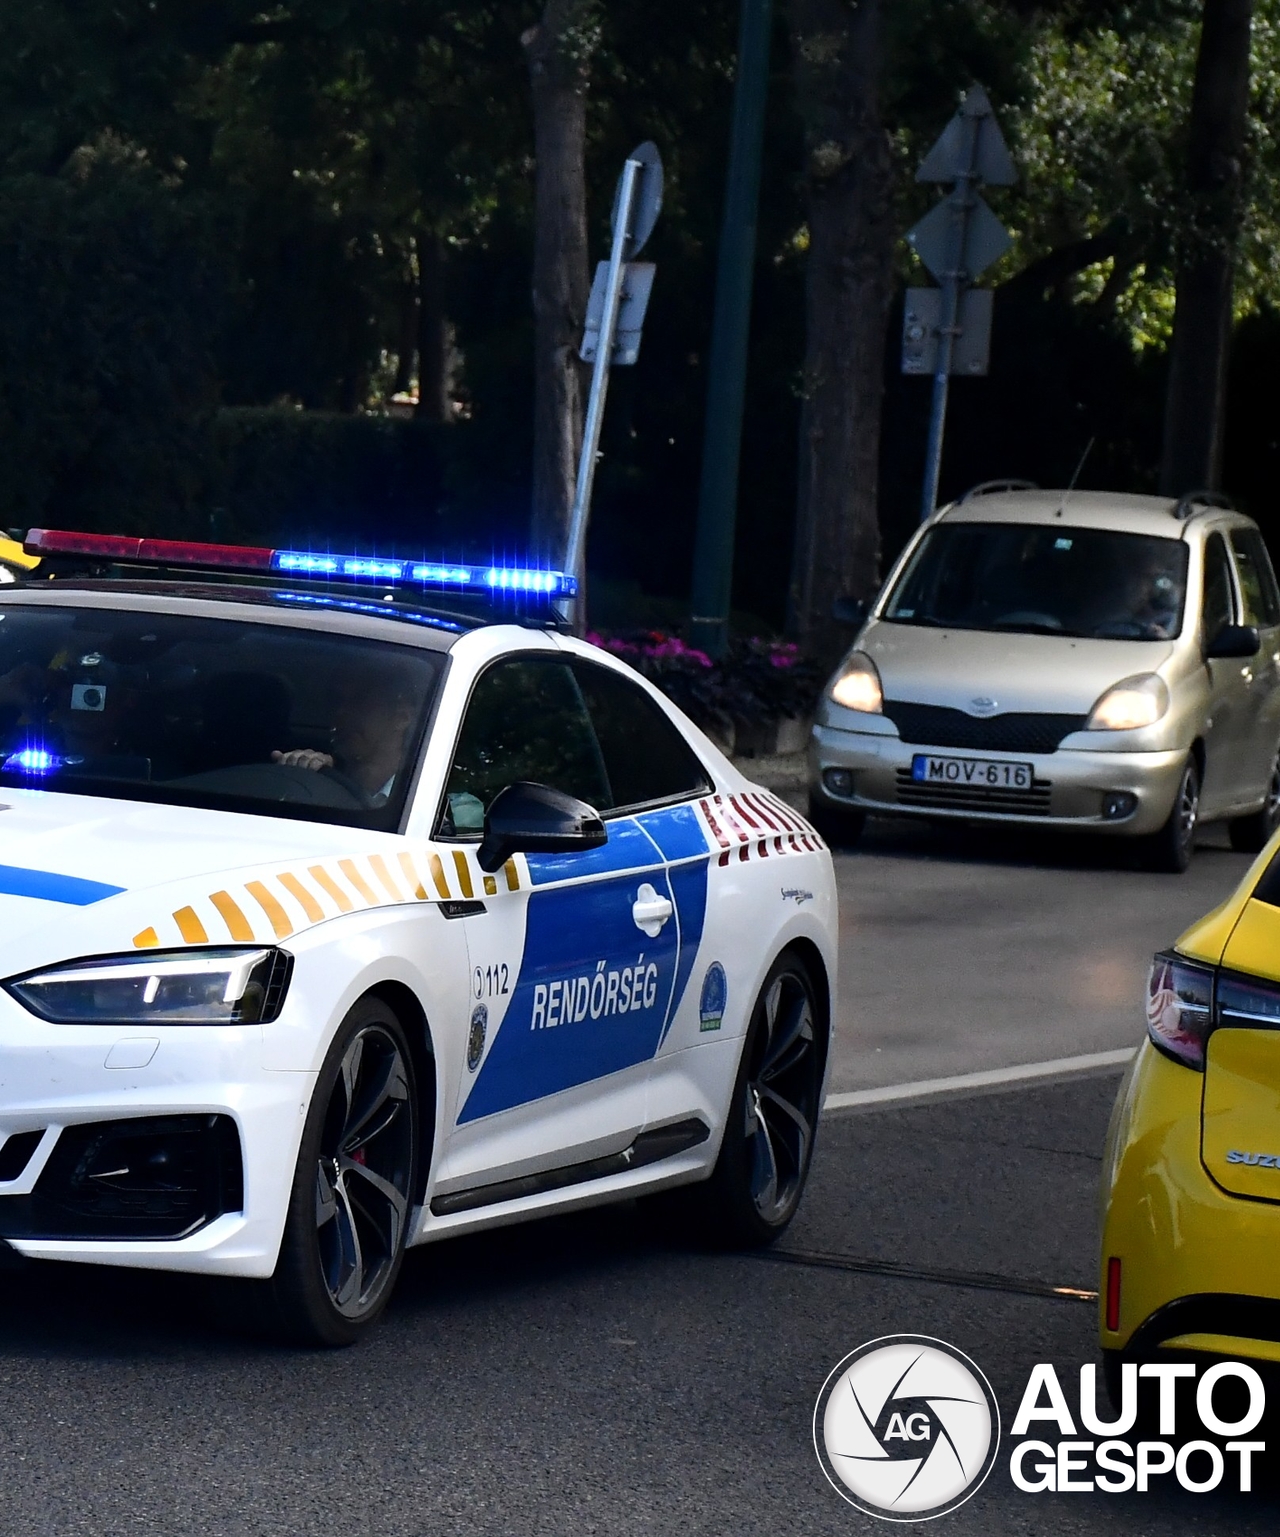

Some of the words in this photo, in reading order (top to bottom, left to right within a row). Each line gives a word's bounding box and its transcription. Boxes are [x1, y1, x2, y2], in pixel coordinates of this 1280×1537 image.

[929, 761, 1026, 786] MOV-616
[486, 963, 509, 997] 112
[530, 953, 658, 1030] RENDŐRSÉG
